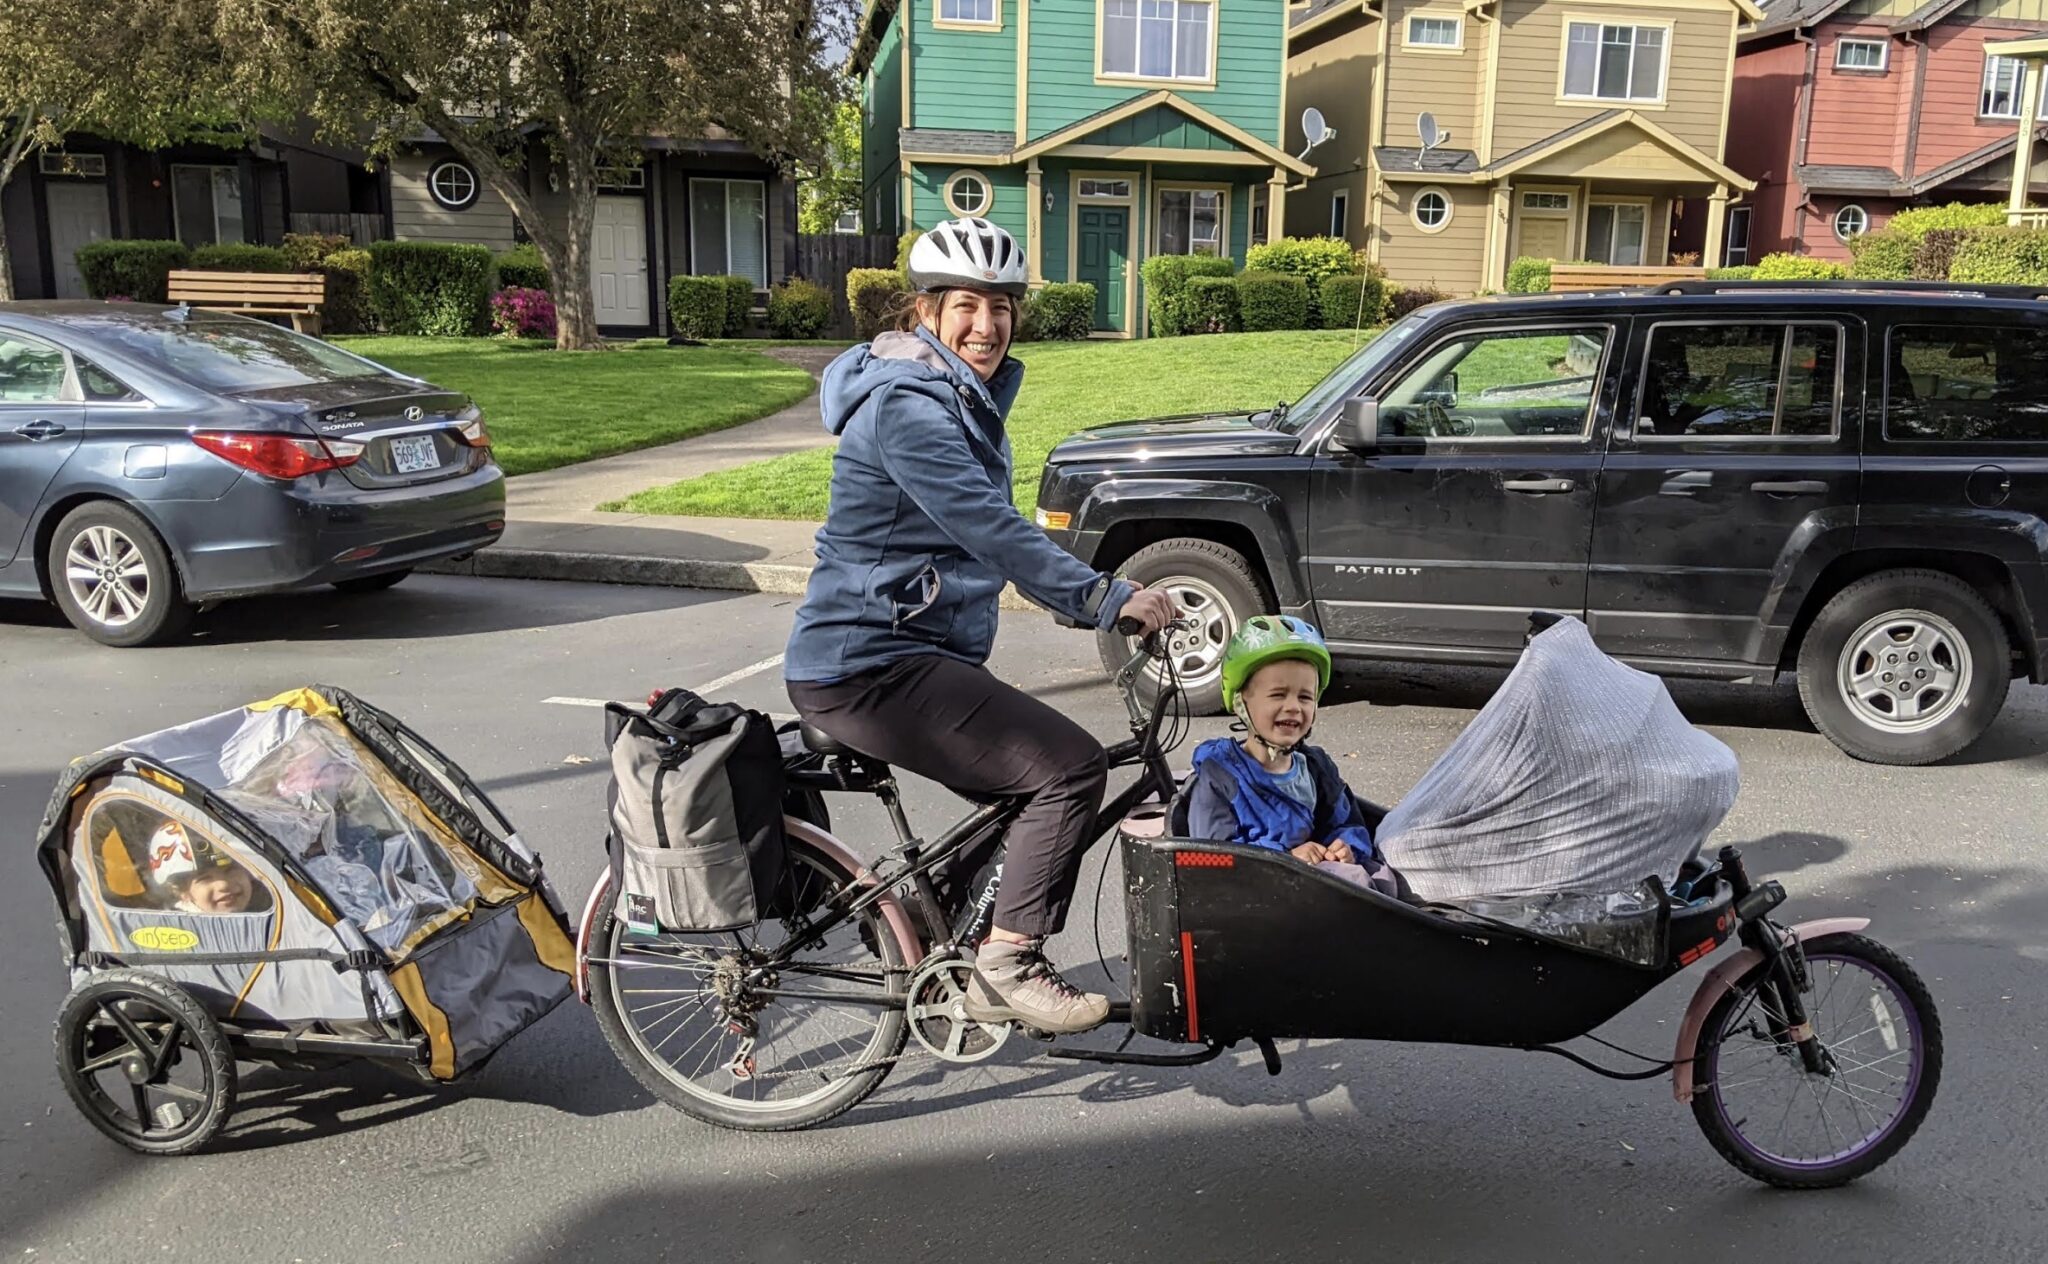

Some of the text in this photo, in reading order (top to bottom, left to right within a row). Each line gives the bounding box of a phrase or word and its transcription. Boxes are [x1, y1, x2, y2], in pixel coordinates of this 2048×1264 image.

[321, 421, 365, 432] SONATA
[394, 444, 436, 465] 569 JVF
[1334, 565, 1422, 575] PATRIOT
